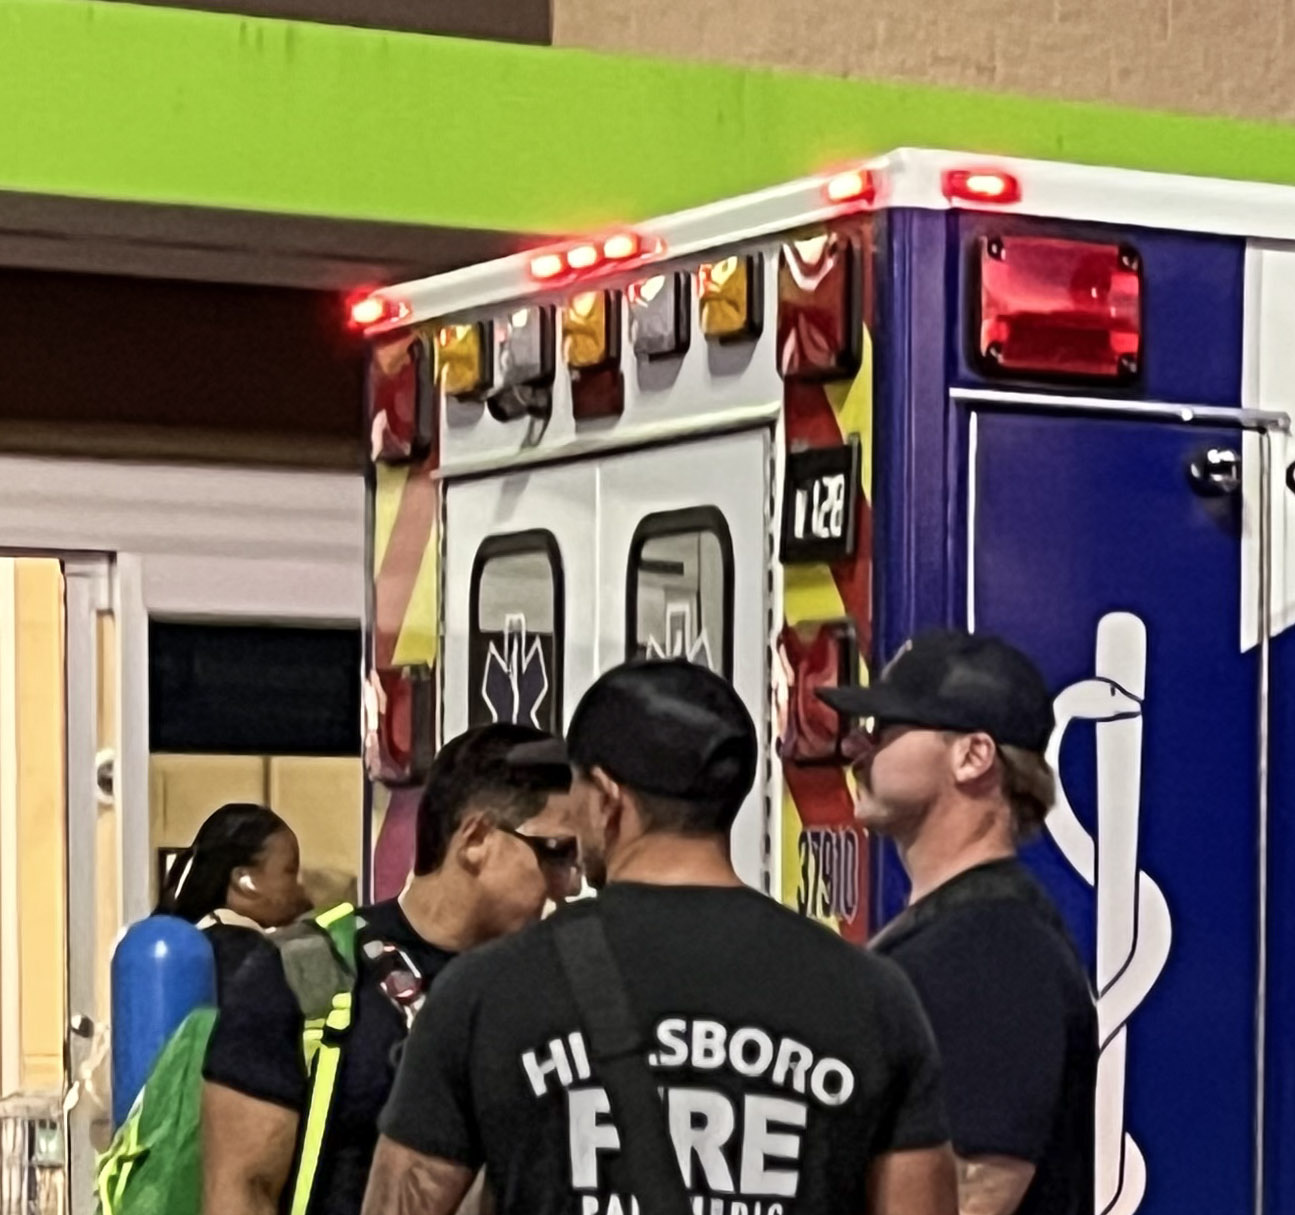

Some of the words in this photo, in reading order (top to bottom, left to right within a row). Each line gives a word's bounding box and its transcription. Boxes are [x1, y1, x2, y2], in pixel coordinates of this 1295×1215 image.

[811, 473, 846, 539] 128
[797, 828, 859, 922] 37910
[521, 1017, 855, 1106] HISBORO
[567, 1085, 808, 1198] FRE
